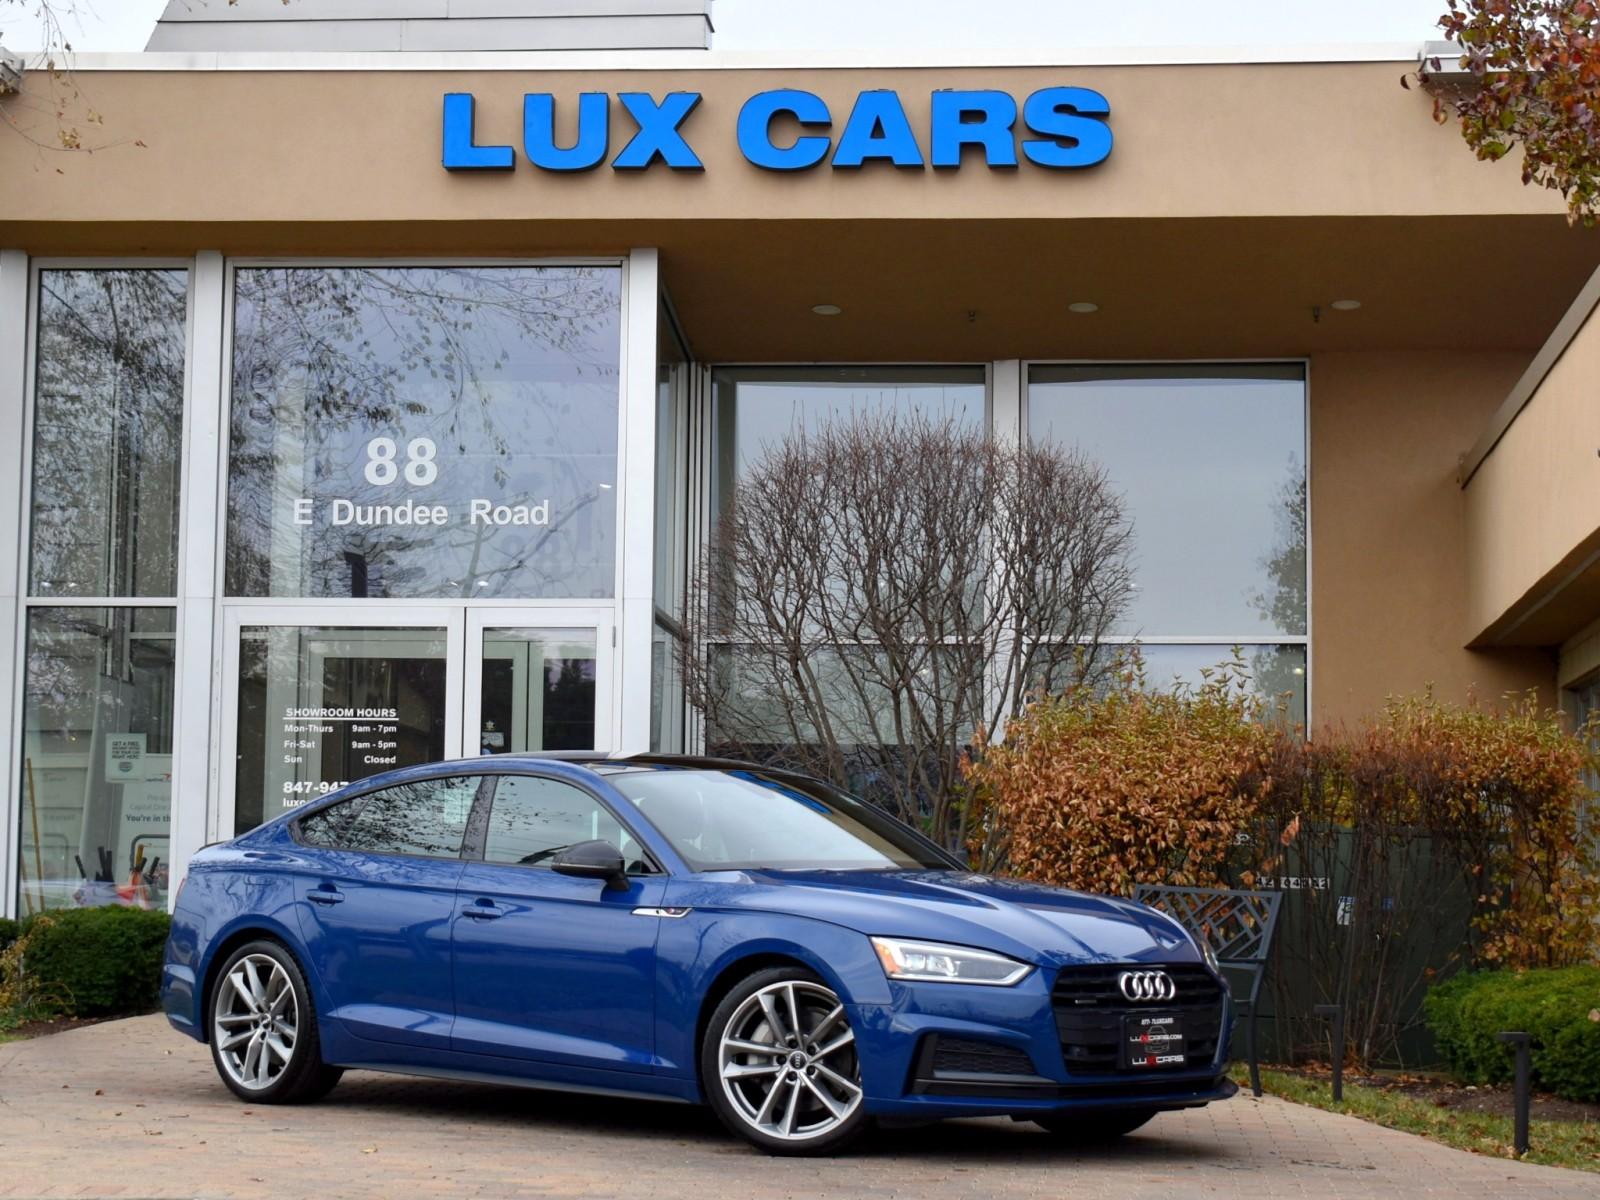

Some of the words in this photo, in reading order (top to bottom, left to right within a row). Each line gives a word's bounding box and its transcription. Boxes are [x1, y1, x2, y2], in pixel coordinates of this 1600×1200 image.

[442, 92, 704, 171] LUX
[736, 87, 1114, 171] CARS
[364, 437, 437, 486] 88
[293, 498, 313, 525] E
[332, 498, 448, 525] Dundee
[470, 498, 549, 526] Road
[286, 708, 354, 717] SHOWROOM
[356, 708, 397, 717] HOURS
[284, 724, 334, 733] Mon-Thurs
[352, 724, 370, 733] 9am
[378, 724, 397, 734] 7pm
[284, 740, 316, 748] Fri-Sat
[352, 741, 370, 749] 9am
[378, 740, 397, 750] 5pm
[284, 755, 302, 763] Sun
[364, 755, 397, 764] Closed
[153, 814, 161, 822] in
